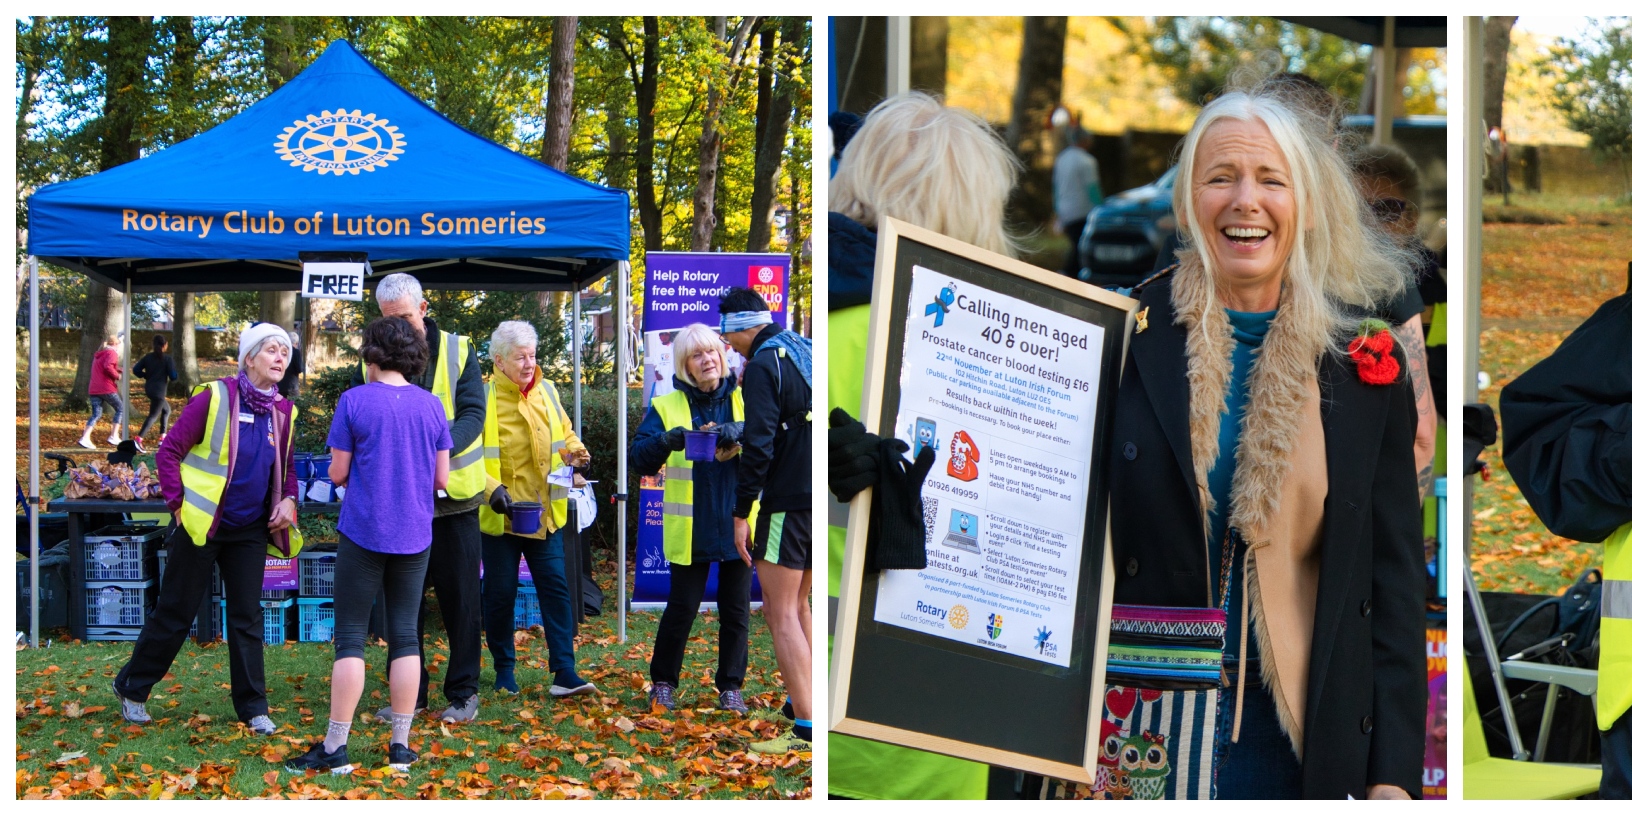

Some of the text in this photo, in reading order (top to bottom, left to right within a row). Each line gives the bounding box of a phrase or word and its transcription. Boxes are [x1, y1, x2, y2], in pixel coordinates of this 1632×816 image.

[314, 116, 367, 127] ROTARY
[293, 151, 387, 169] INTERNATIONAL
[122, 209, 546, 239] Rotary Club of Luton Someries
[307, 273, 359, 295] FREE
[653, 269, 719, 283] Help Rotary
[652, 285, 675, 296] free
[678, 285, 696, 296] the
[652, 300, 710, 314] from polio
[957, 294, 1087, 350] Calling men aged
[981, 326, 1059, 363] 40 & over!
[922, 330, 1089, 392] Prostate cancer blood testing £16
[954, 357, 992, 377] November
[994, 372, 1002, 380] at
[1004, 373, 1027, 387] Luton
[1029, 381, 1045, 393] Irish
[1046, 387, 1071, 401] Forum
[926, 368, 947, 380] (Public
[958, 380, 982, 394] parking
[982, 388, 1010, 400] available
[1011, 397, 1036, 409] adjacent
[1045, 406, 1055, 415] the
[1057, 409, 1078, 422] Forum)
[946, 388, 1057, 430] Results back within the week!
[969, 411, 998, 426] necessary.
[1007, 422, 1020, 431] book
[1036, 431, 1052, 440] place
[1053, 436, 1070, 445] either:
[990, 449, 1006, 459] Lines
[1007, 455, 1021, 463] open
[1023, 460, 1053, 474] weekdays
[989, 472, 1004, 482] Have
[1006, 478, 1020, 486] your
[1022, 481, 1034, 490] NHS
[1036, 487, 1058, 497] number
[1014, 465, 1037, 477] arrange
[1038, 470, 1065, 485] bookings
[928, 479, 949, 492] 01926
[951, 486, 979, 500] 419959
[989, 480, 1042, 502] debit card handy!
[646, 518, 664, 526] Pleas
[952, 555, 959, 563] at
[900, 612, 944, 629] Luton Someries
[916, 600, 947, 620] Rotary
[1045, 642, 1057, 651] PSA
[1422, 767, 1445, 787] LP
